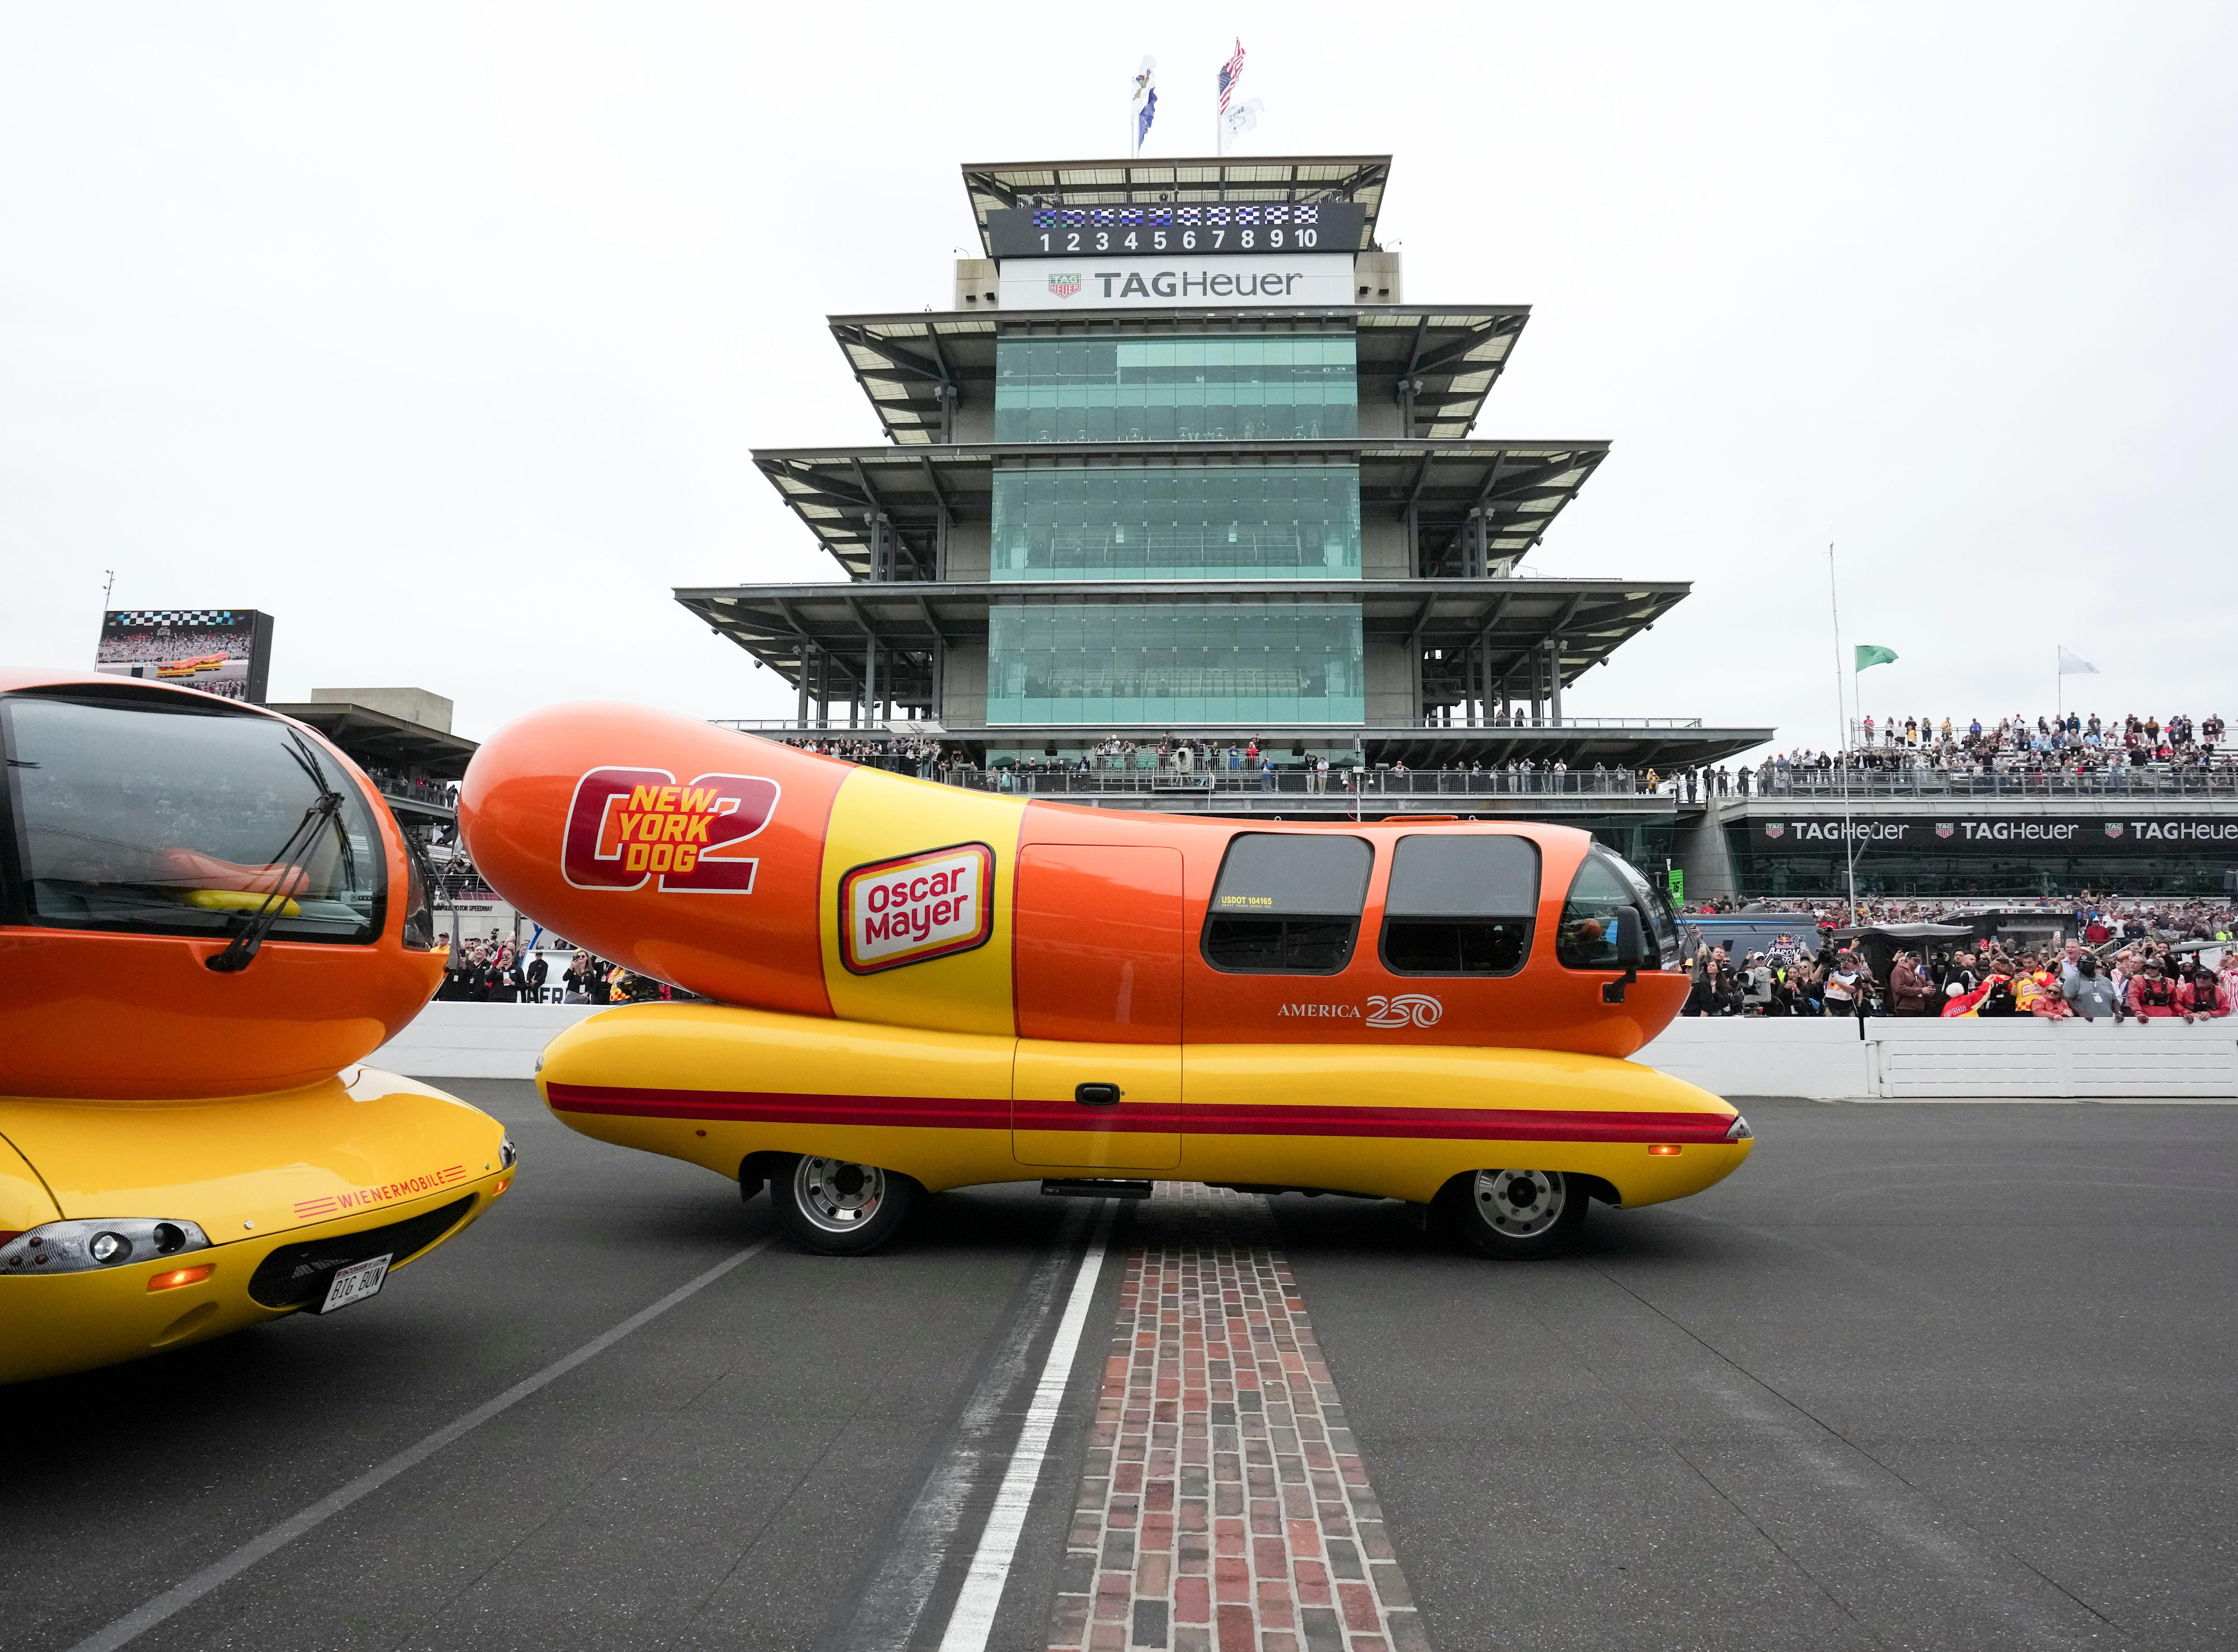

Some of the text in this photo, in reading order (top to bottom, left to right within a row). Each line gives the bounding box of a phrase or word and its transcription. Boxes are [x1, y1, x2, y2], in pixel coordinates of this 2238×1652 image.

[1040, 228, 1317, 251] 1 2 3 4 5 6 7 8 9 10
[1051, 284, 1078, 296] HEUER
[628, 785, 718, 813] NEW
[620, 812, 714, 843] YORK
[1766, 829, 1783, 838] HEUER
[1936, 830, 1954, 838] HEUER
[2105, 830, 2123, 838] HEUER
[626, 843, 697, 872] DOG
[868, 867, 966, 914] Oscar
[1221, 896, 1272, 905] USDOT 104165
[864, 895, 968, 946] Mayer
[1277, 1003, 1361, 1018] AMERICA
[1365, 994, 1443, 1028] 250
[1952, 1004, 1967, 1015] DOG
[336, 1172, 446, 1209] WIENERMOBILE
[336, 1262, 368, 1277] WISCONSIN
[331, 1266, 384, 1301] BIG BUN
